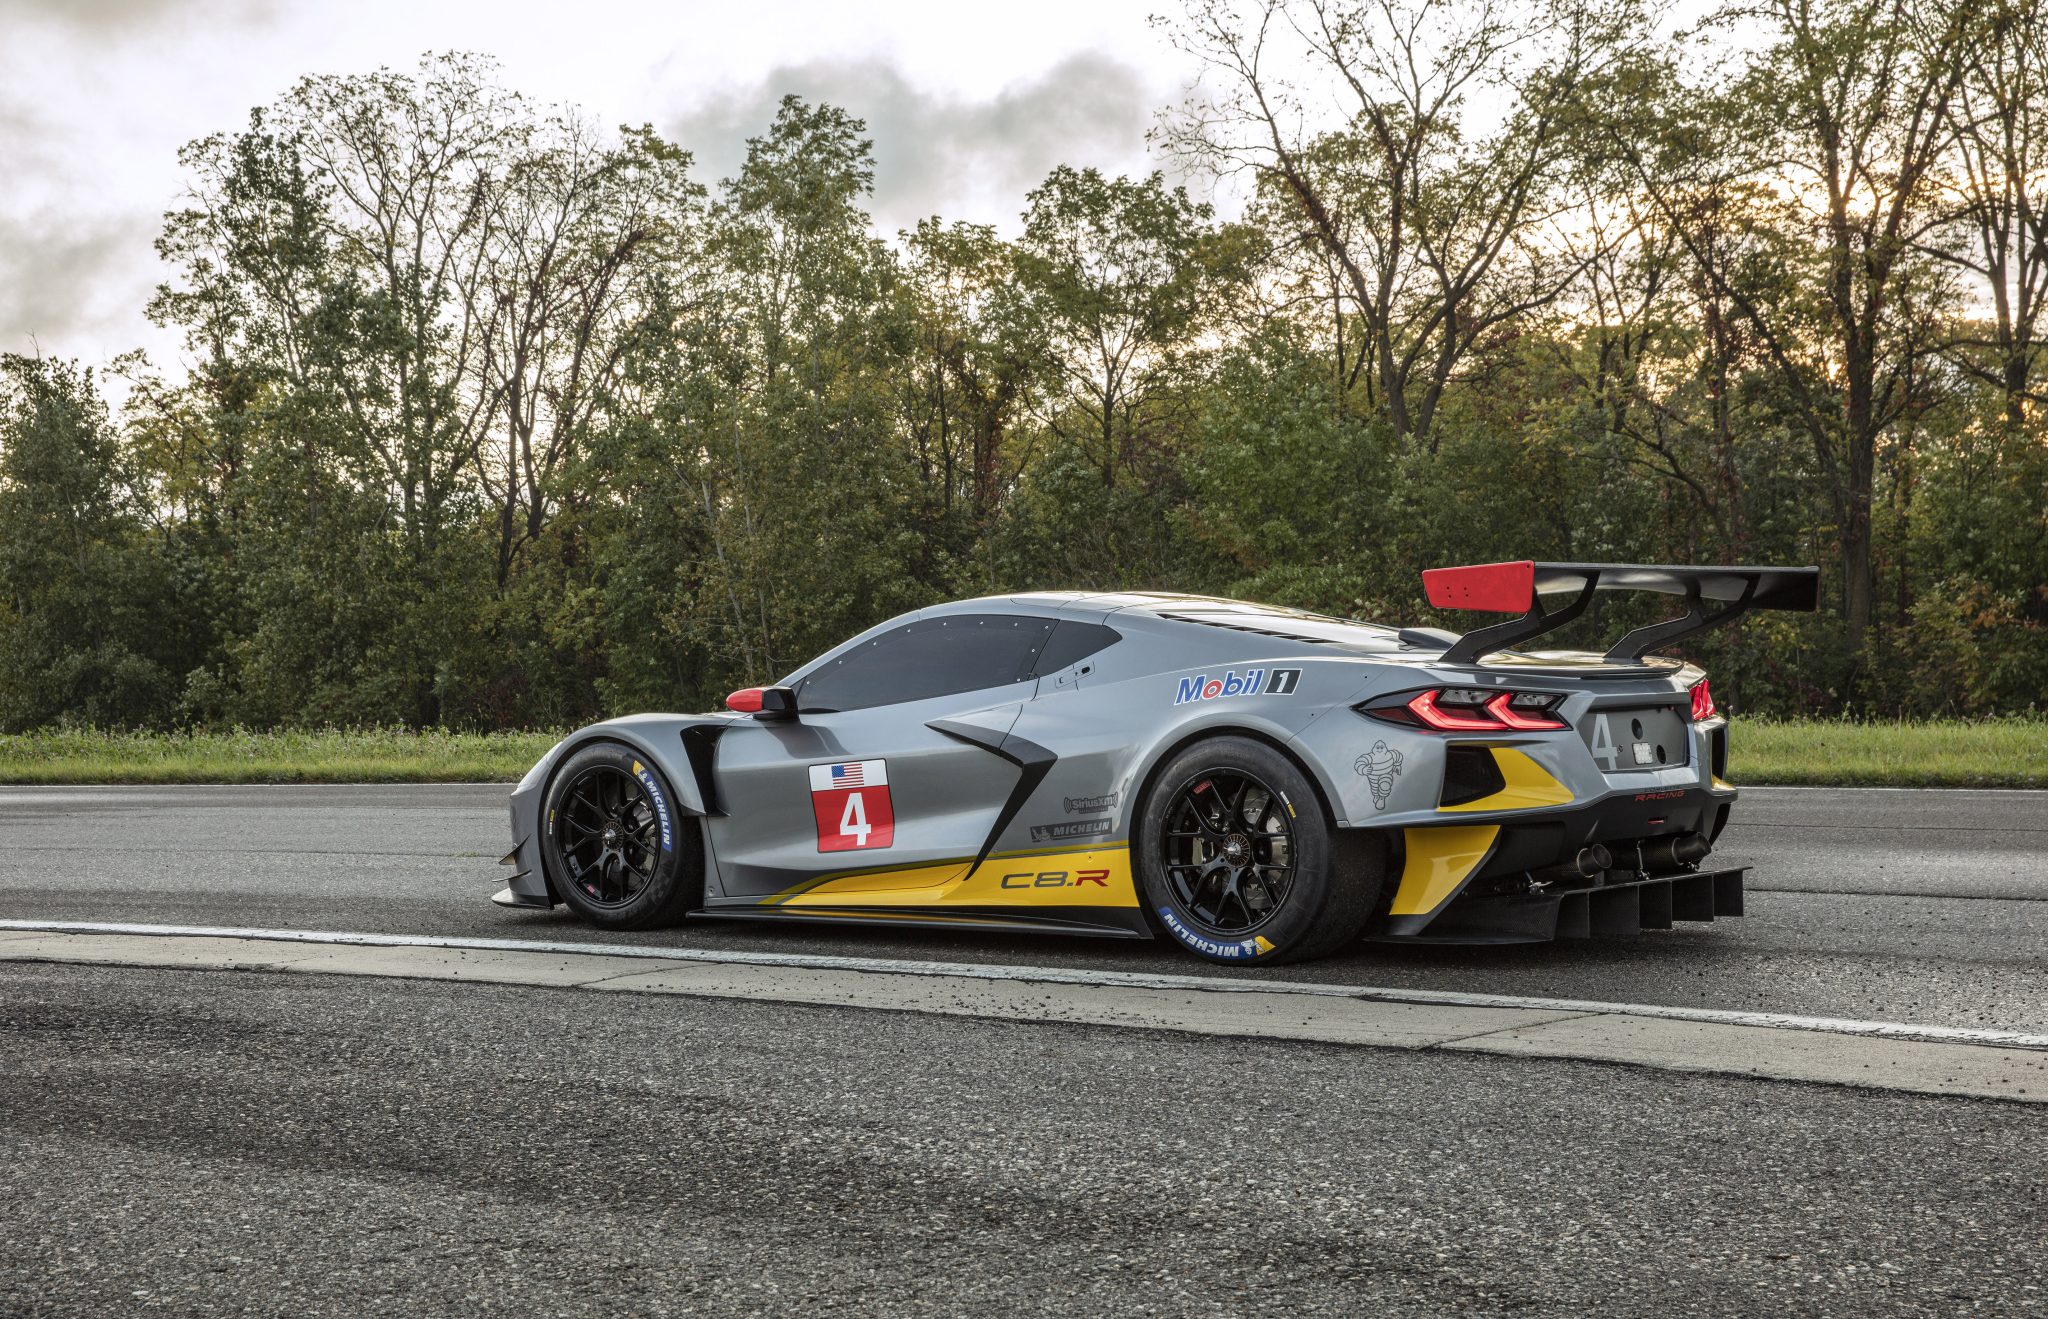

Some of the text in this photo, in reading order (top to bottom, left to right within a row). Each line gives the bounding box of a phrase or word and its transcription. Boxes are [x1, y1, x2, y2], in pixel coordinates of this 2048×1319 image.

[1174, 669, 1264, 705] Mobil
[1591, 713, 1618, 770] 4
[645, 780, 670, 845] MICHELIN
[1634, 789, 1685, 801] RACING
[839, 792, 872, 846] 4
[1053, 821, 1110, 835] MICHELIN
[1001, 869, 1110, 889] C8.R
[1163, 913, 1240, 957] MICHELIN
